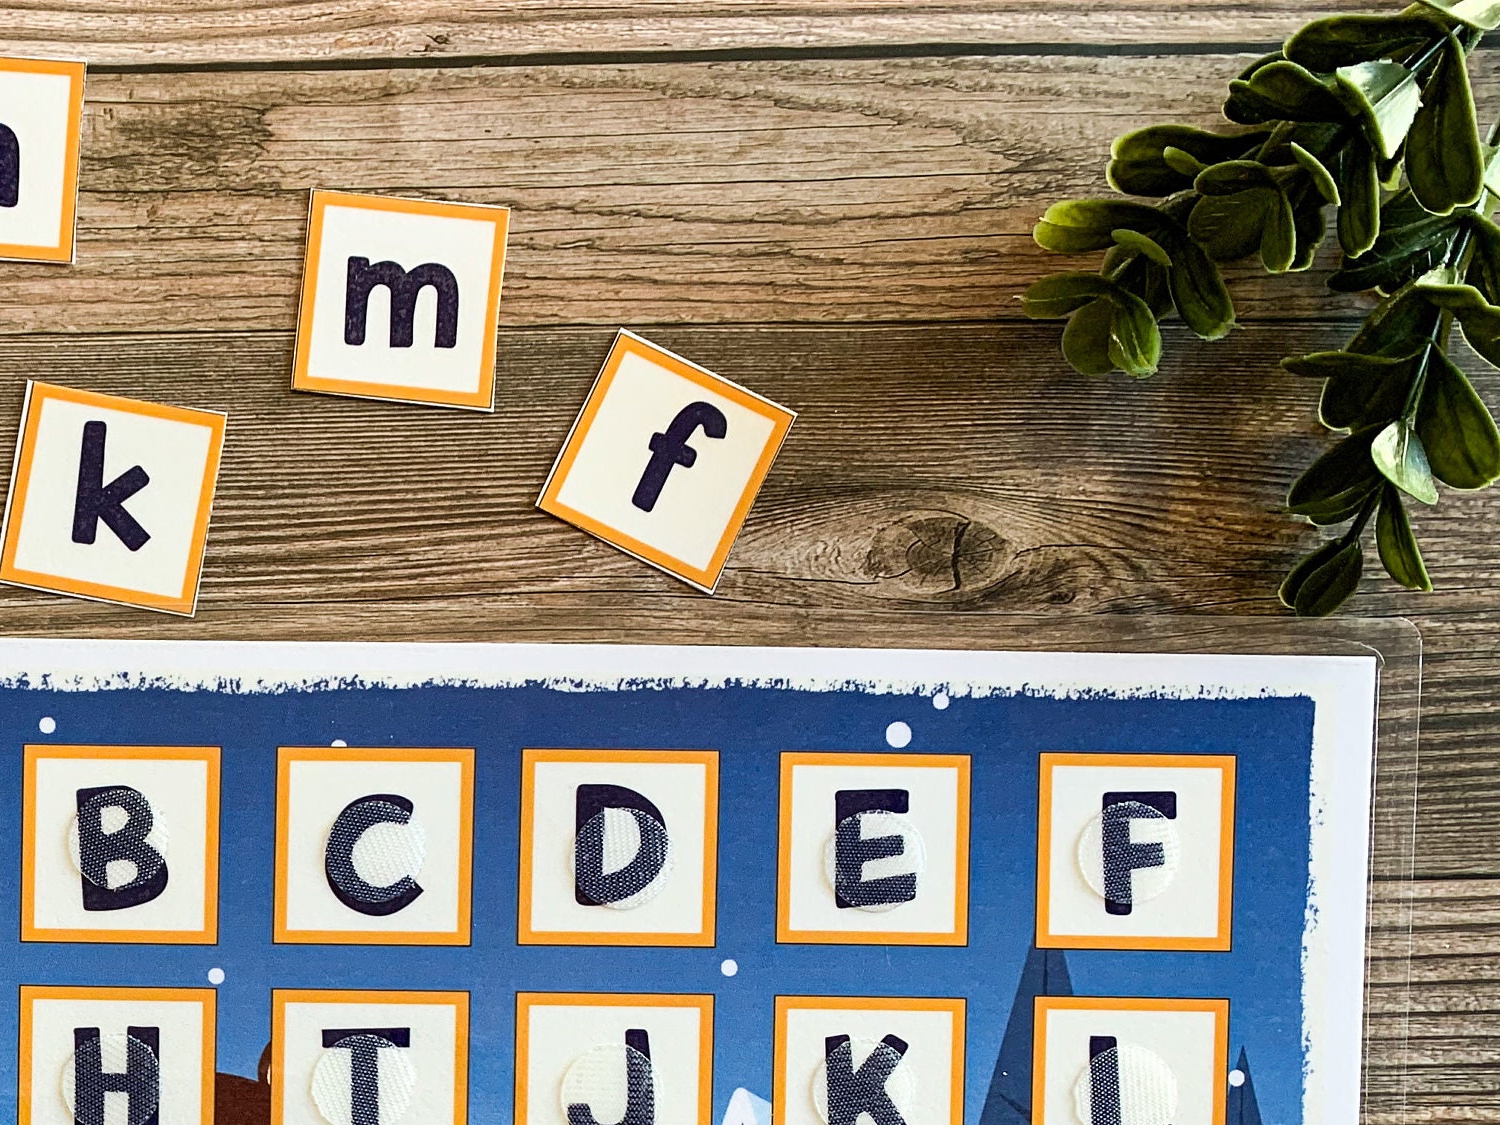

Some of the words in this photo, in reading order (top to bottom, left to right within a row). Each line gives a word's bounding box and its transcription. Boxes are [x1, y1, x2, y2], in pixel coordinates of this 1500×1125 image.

[344, 256, 458, 348] m
[72, 421, 151, 551] k
[632, 402, 727, 512] f
[76, 785, 168, 911] B
[325, 794, 424, 916] C
[575, 784, 668, 906] D
[835, 789, 916, 909] E
[1102, 791, 1177, 915] F
